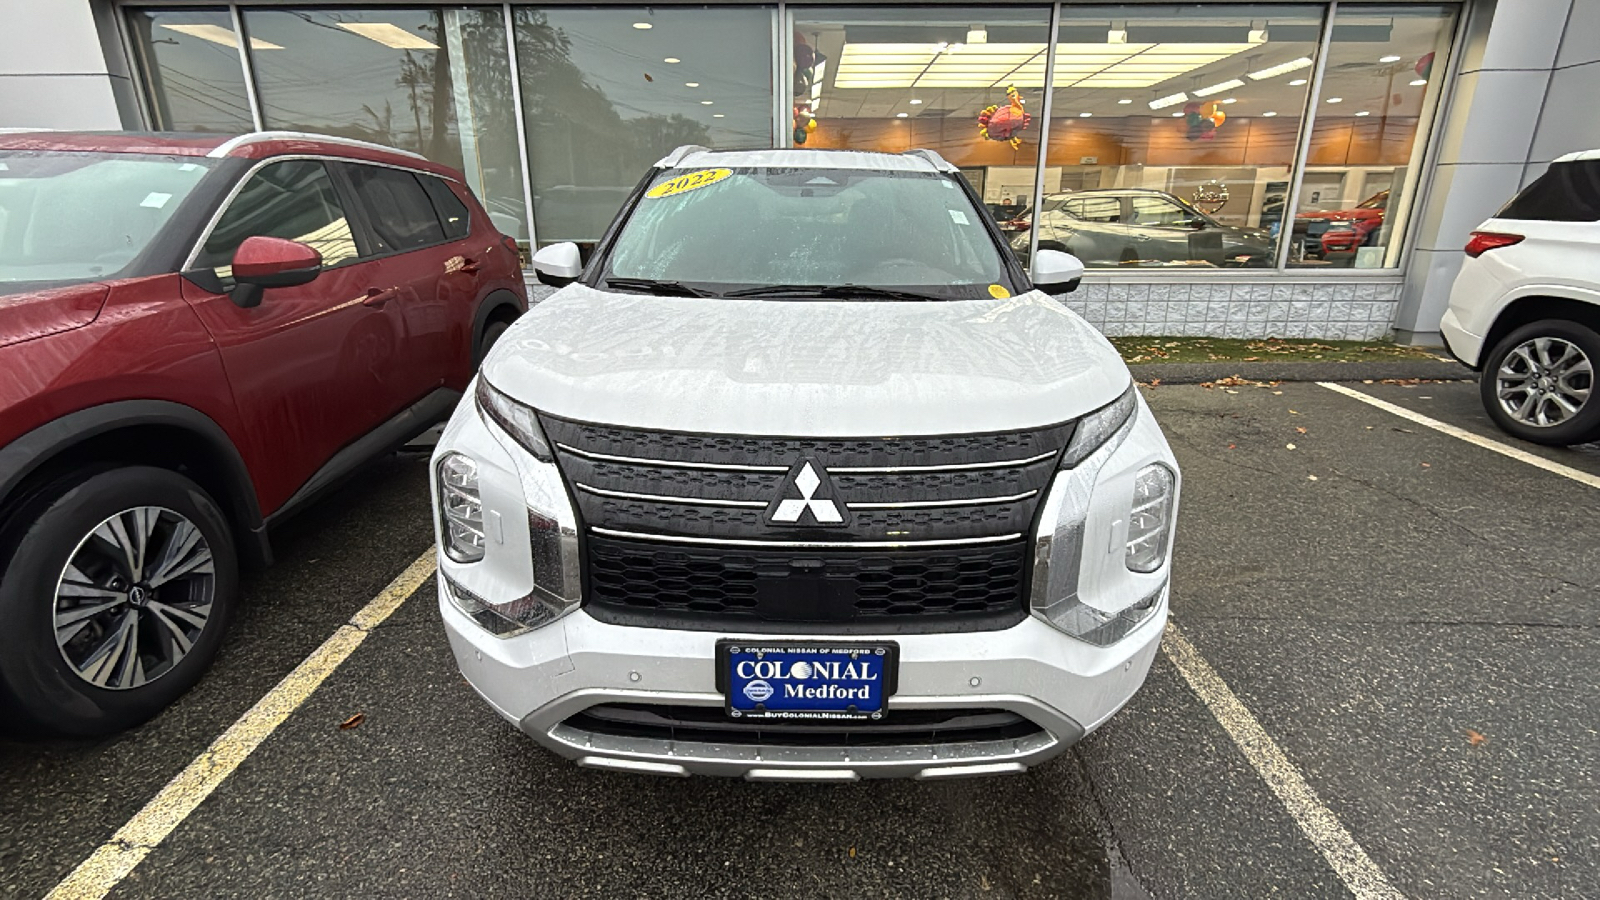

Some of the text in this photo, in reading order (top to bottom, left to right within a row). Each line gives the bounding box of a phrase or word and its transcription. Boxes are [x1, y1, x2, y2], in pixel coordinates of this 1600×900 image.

[661, 171, 717, 195] 2022
[736, 661, 878, 681] COLONIAL
[784, 684, 870, 699] Medford
